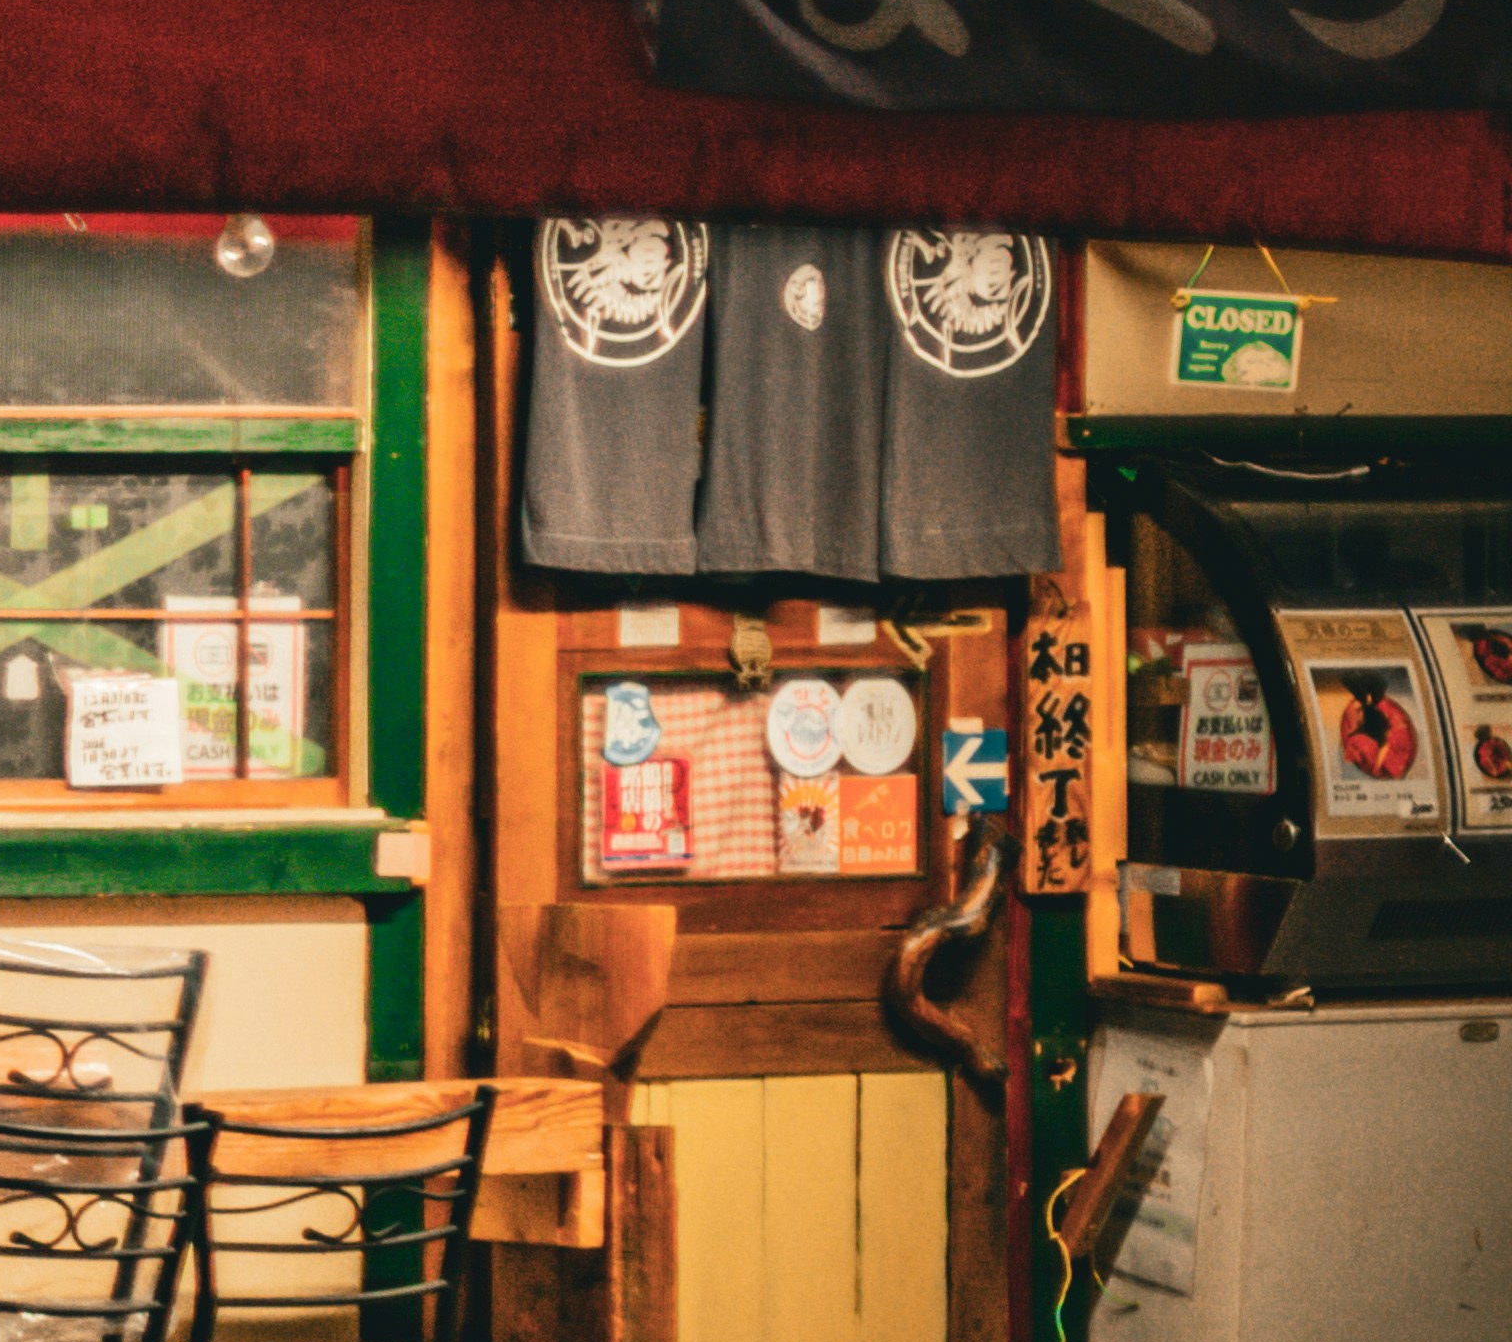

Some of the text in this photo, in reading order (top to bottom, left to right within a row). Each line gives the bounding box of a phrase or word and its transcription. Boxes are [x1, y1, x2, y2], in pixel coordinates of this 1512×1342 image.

[1186, 304, 1293, 335] CLOSED
[187, 744, 230, 760] CASH
[1193, 769, 1261, 786] CASH ONLY
